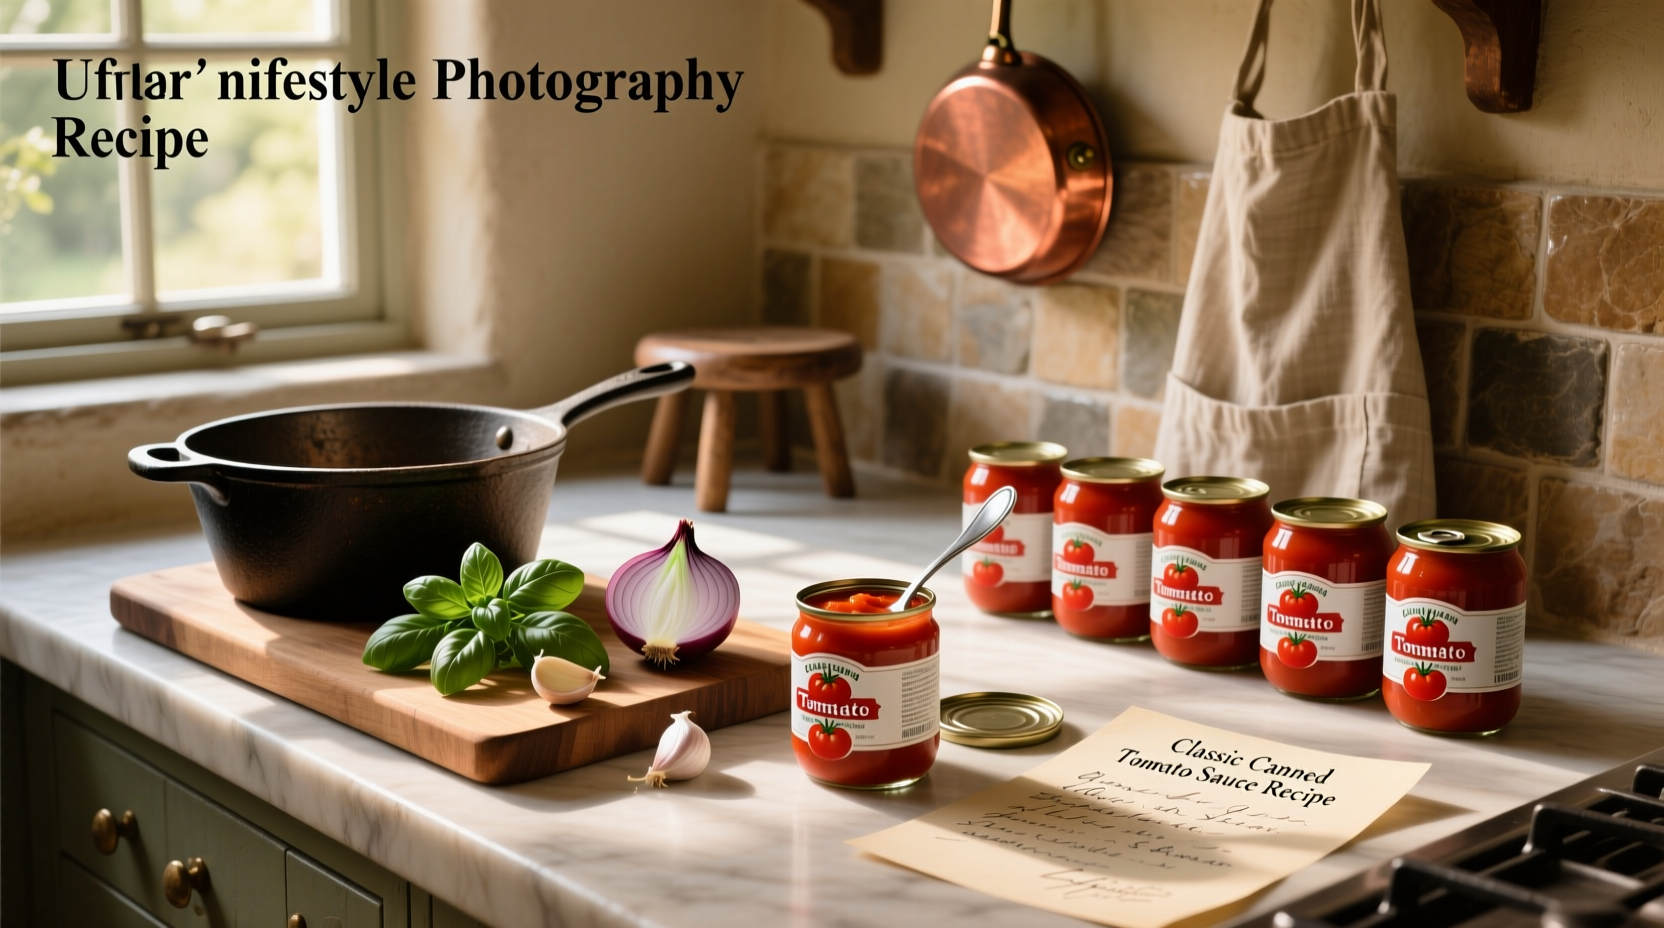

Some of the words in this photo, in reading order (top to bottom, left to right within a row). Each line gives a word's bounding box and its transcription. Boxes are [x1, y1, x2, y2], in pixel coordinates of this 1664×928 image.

[1170, 738, 1243, 767] Classic
[1249, 756, 1335, 786] Canned
[1195, 766, 1259, 792] Sauce
[1261, 780, 1336, 809] Recipe
